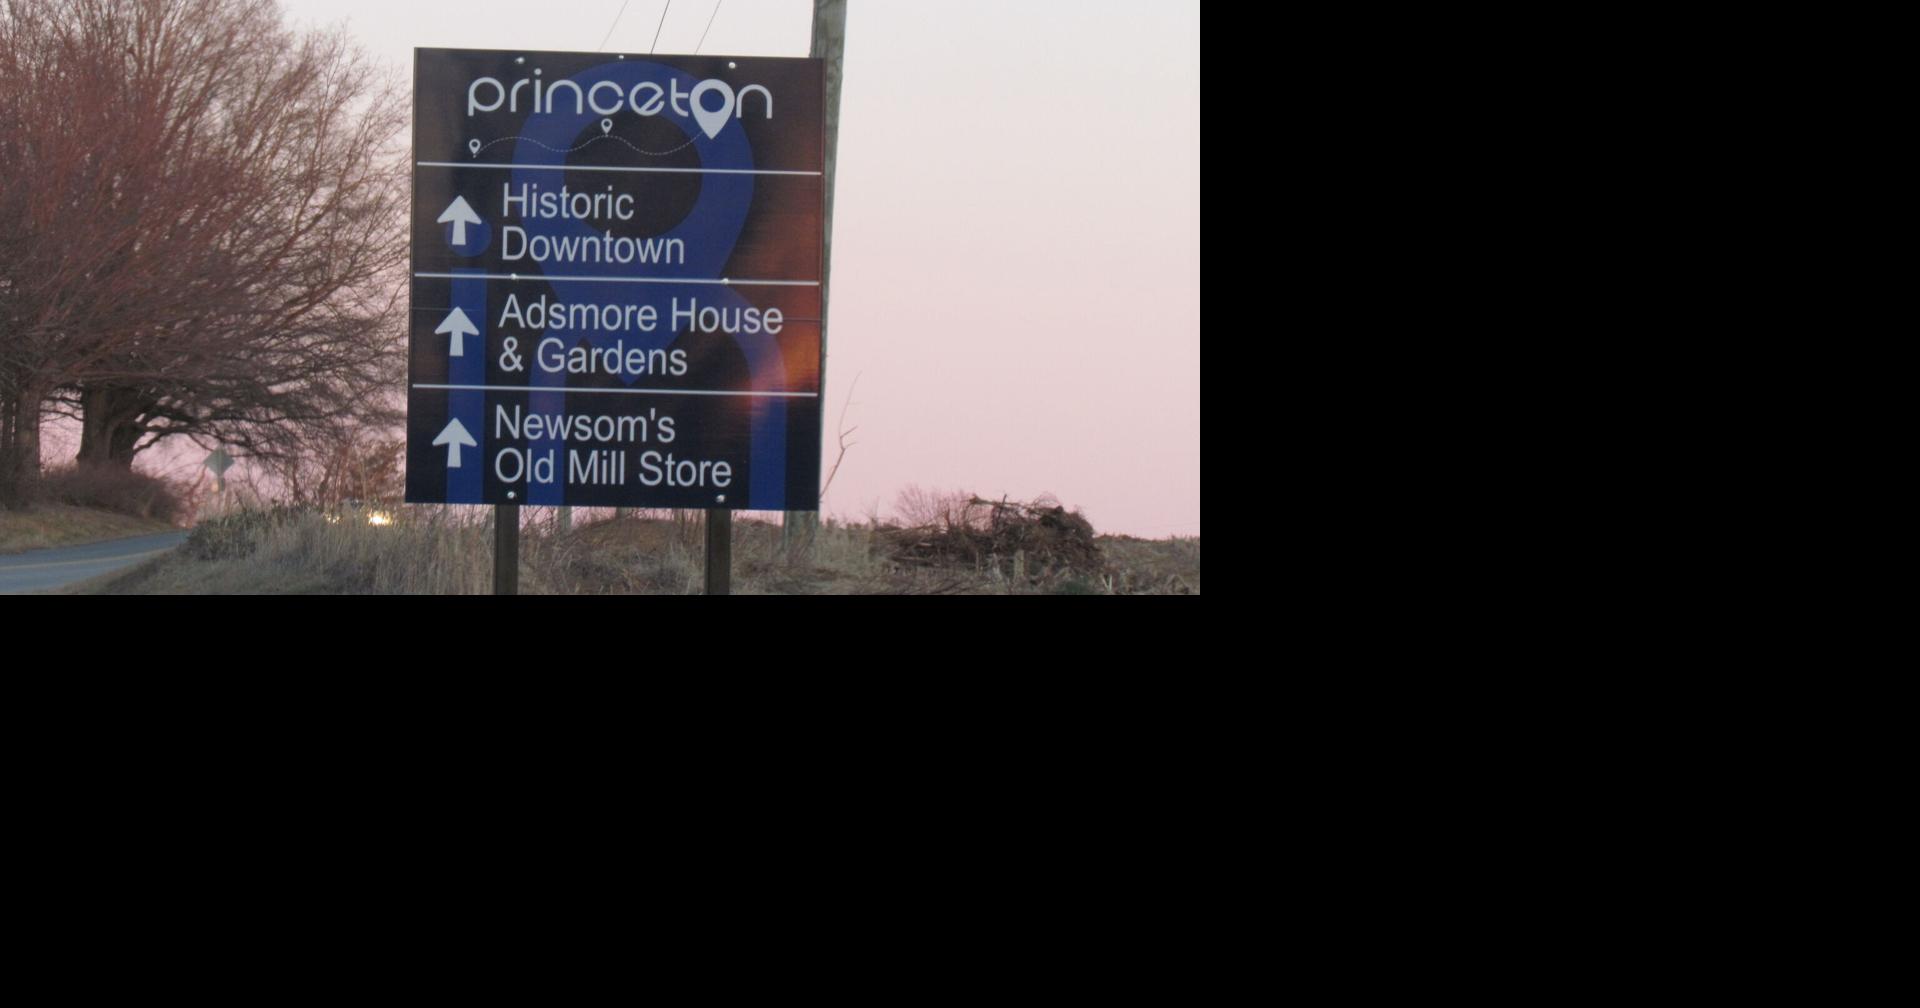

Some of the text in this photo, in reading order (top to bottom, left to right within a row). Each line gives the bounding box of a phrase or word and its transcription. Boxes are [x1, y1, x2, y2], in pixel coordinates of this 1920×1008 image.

[467, 68, 773, 140] princeton
[502, 182, 635, 221] Historic
[501, 226, 685, 265] Downtown
[498, 294, 783, 334] Adsmore House
[499, 336, 688, 376] & Gardens
[495, 404, 676, 443] Newsom's
[495, 447, 732, 487] Old Mill Store
